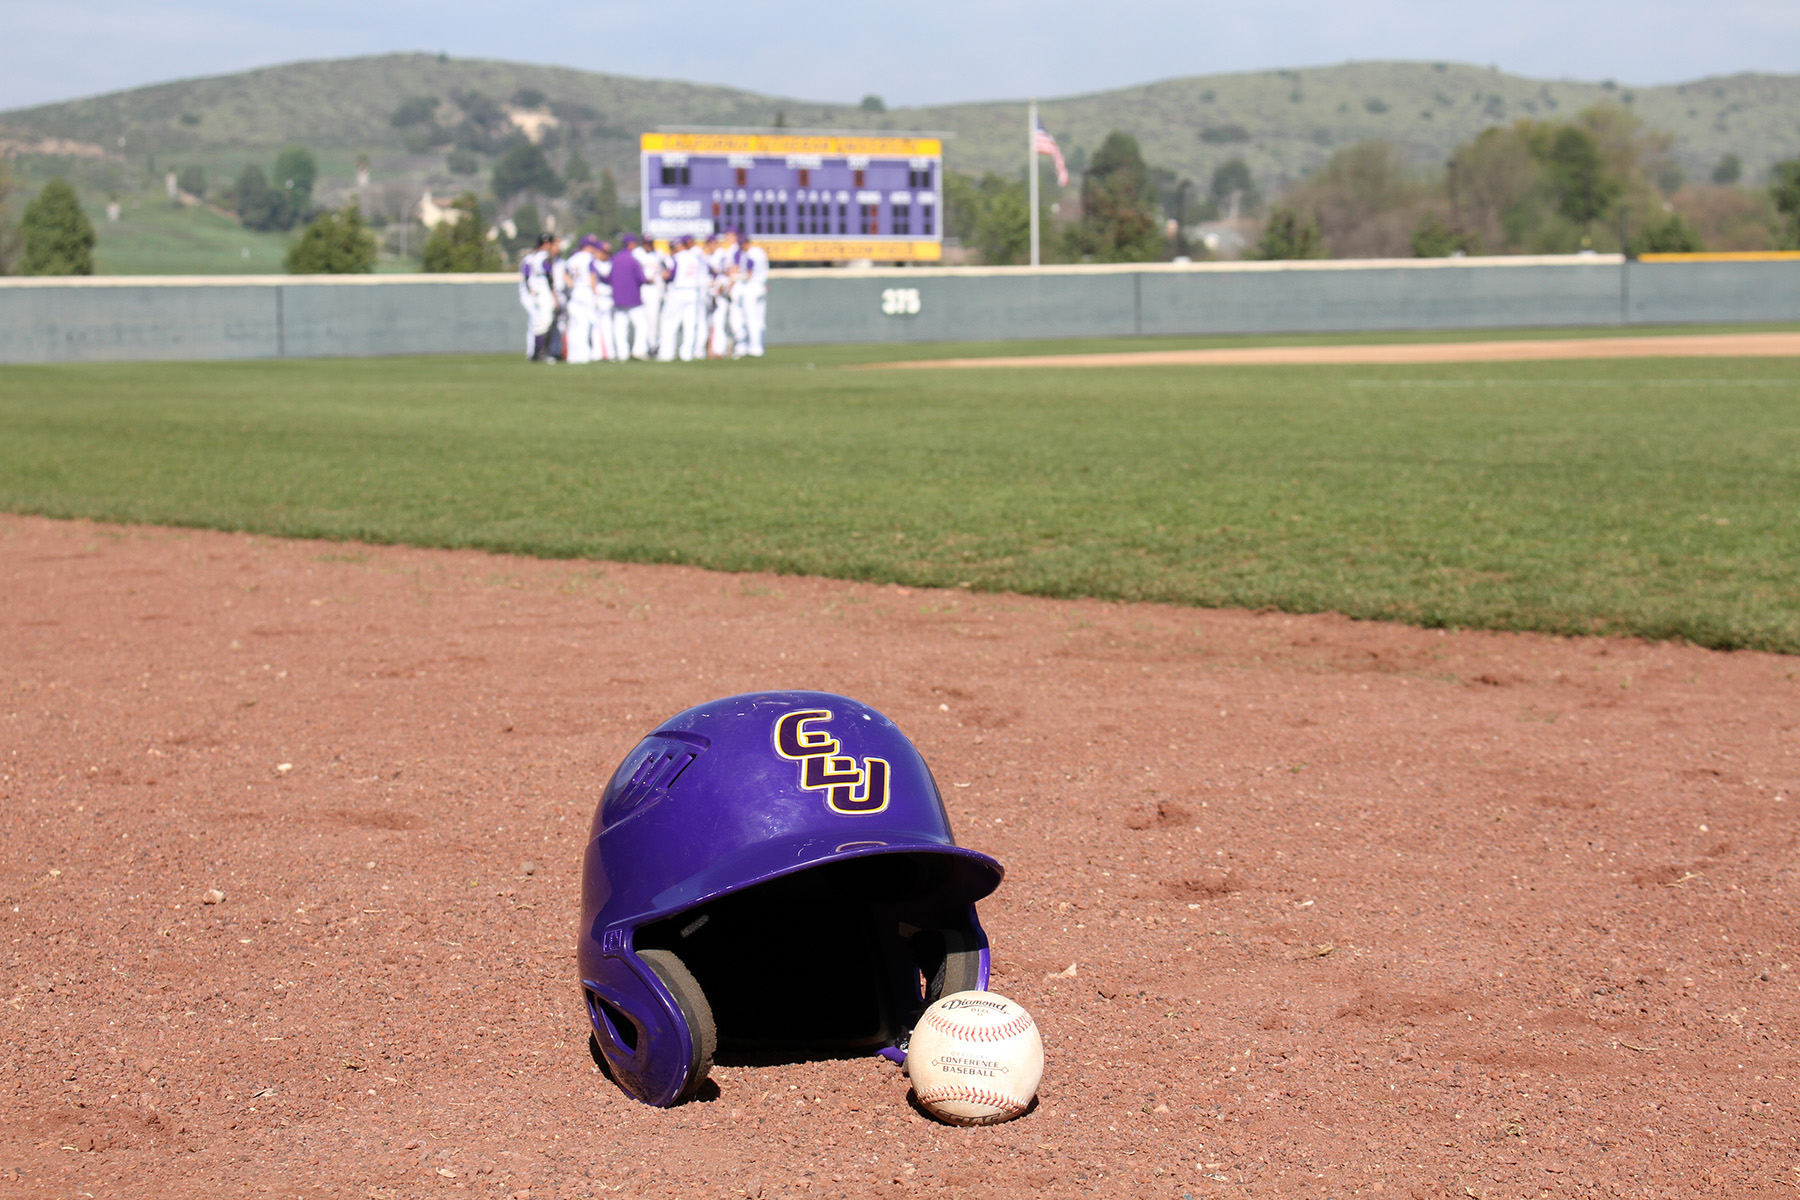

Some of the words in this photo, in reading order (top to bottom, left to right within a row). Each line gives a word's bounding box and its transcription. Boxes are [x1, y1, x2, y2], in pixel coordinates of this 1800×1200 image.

[881, 288, 921, 314] 375
[774, 709, 892, 815] CLU
[941, 998, 1008, 1012] Diamond
[940, 1056, 999, 1068] CONFERENCE
[942, 1065, 996, 1077] BASEBALL
